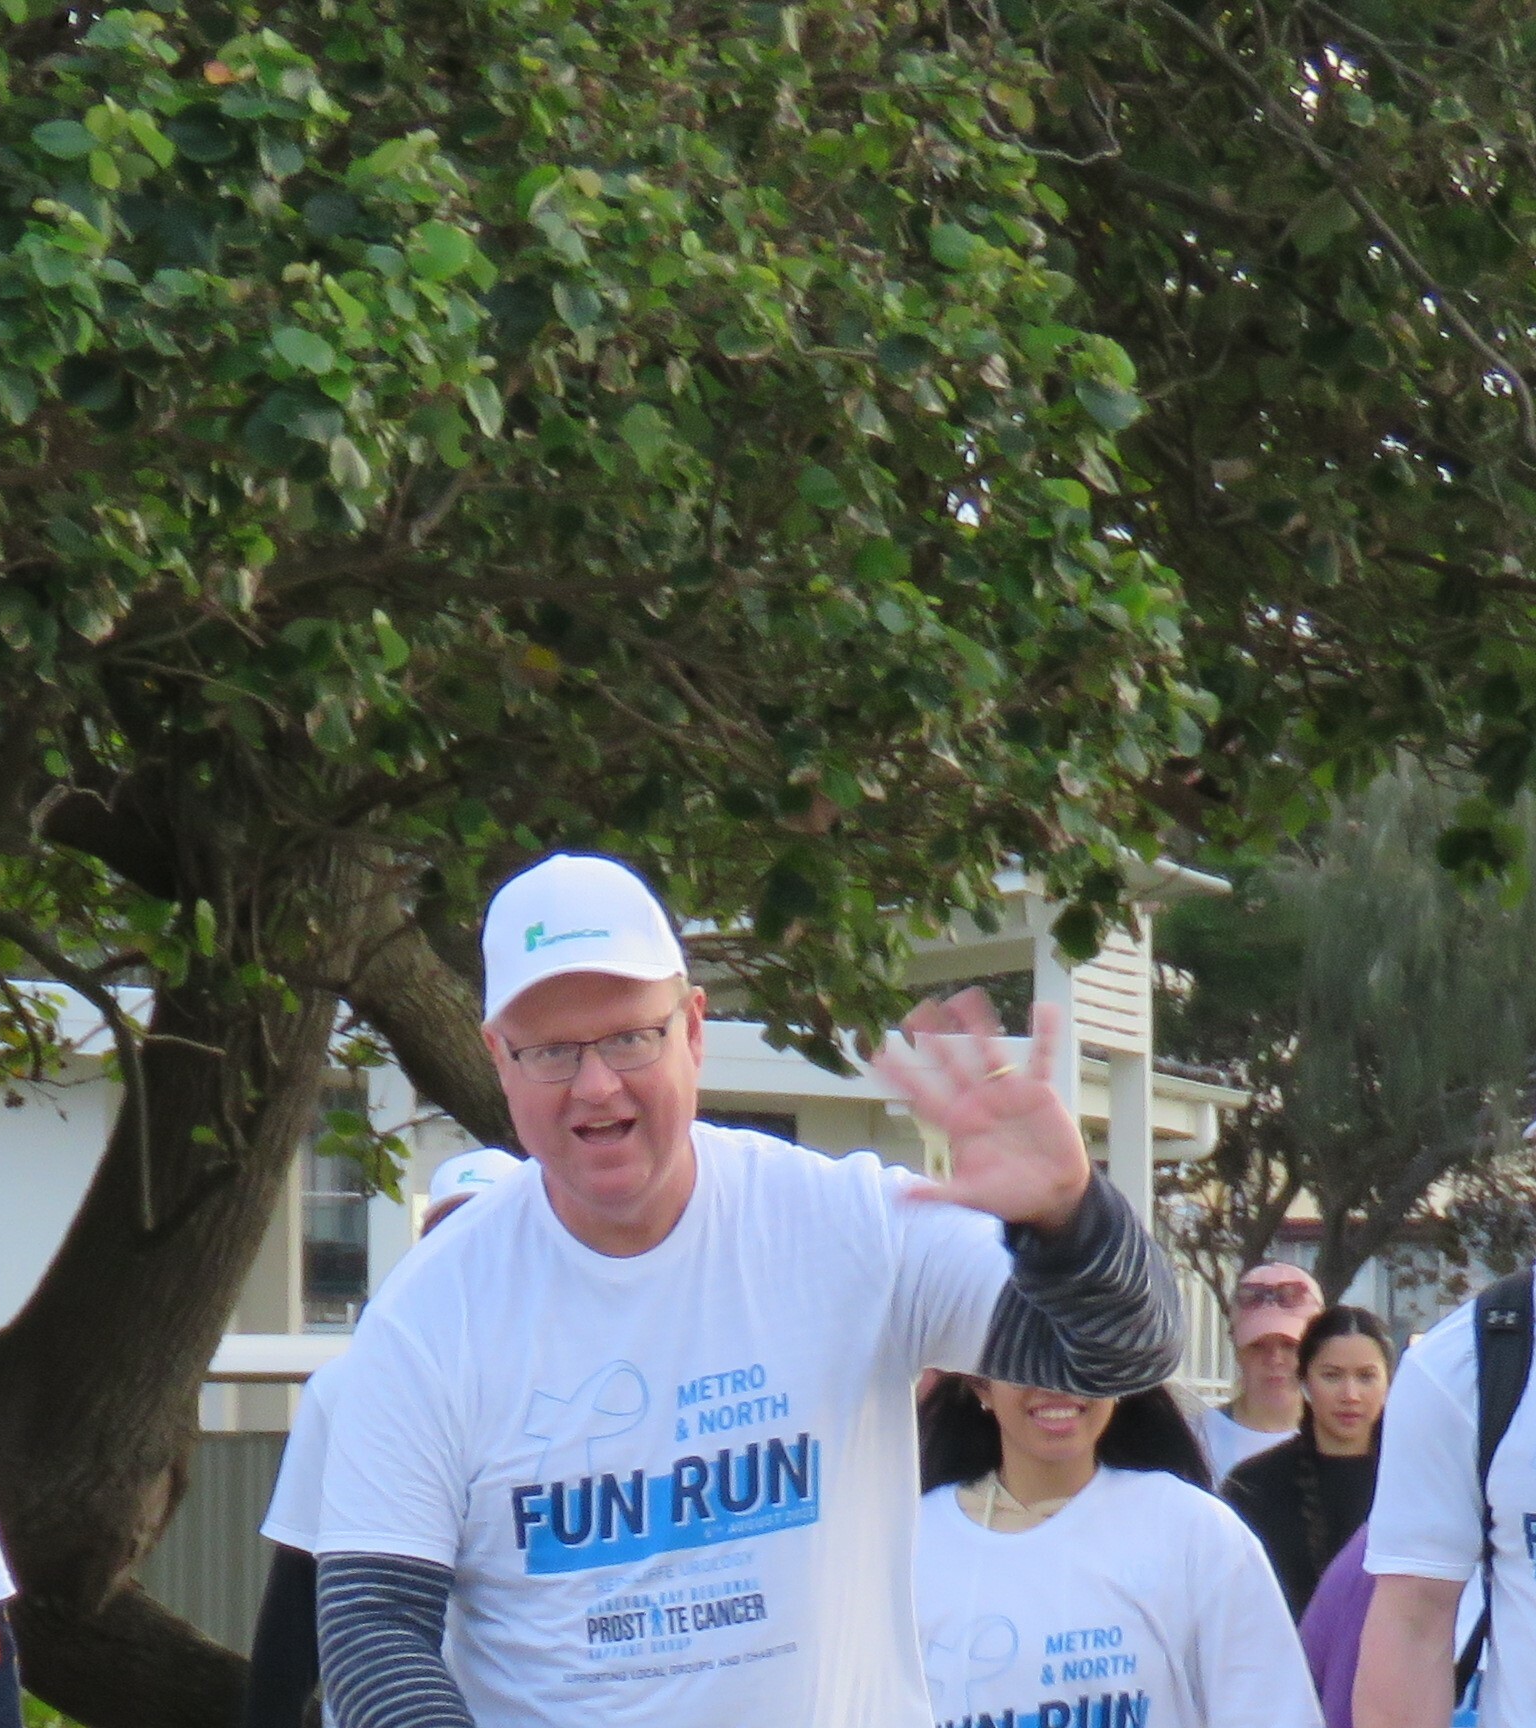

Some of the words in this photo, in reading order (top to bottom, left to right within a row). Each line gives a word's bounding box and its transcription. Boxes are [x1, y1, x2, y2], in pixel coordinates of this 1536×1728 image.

[676, 1363, 766, 1408] METRO
[675, 1418, 689, 1442] &
[698, 1392, 790, 1435] NORTH
[511, 1469, 645, 1549] FUN
[671, 1432, 811, 1524] RUN
[691, 1593, 768, 1631] CANCER
[1045, 1625, 1123, 1655] METRO
[1040, 1665, 1054, 1686] &
[1061, 1654, 1137, 1682] NORTH
